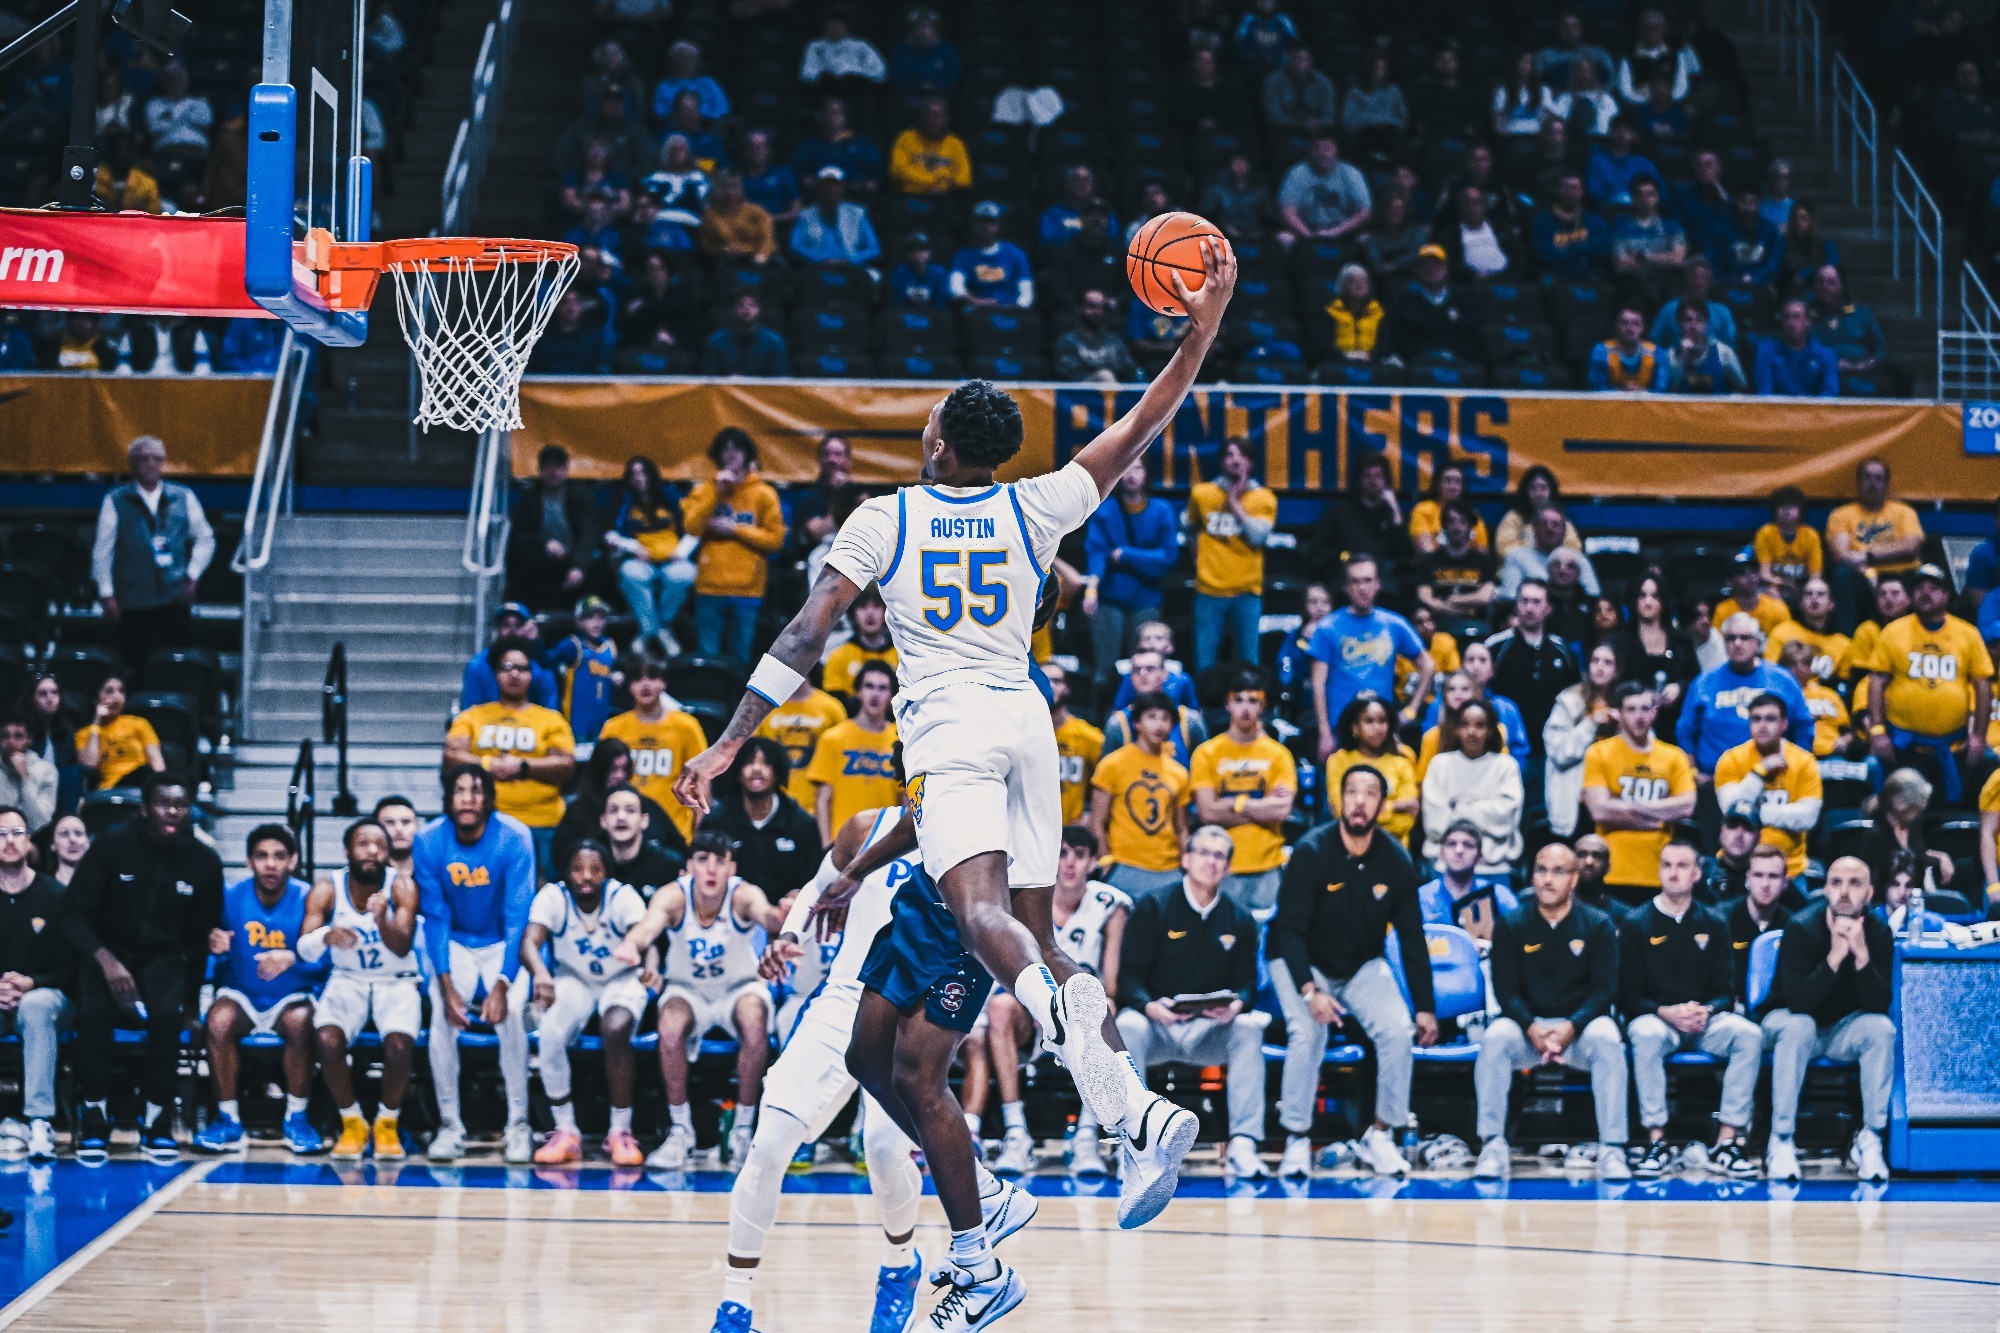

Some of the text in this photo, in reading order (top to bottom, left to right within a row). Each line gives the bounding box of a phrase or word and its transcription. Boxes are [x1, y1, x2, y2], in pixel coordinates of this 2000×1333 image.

[931, 517, 995, 538] AUSTIN
[920, 549, 1010, 634] 55
[1908, 652, 1956, 681] ZOO
[477, 724, 536, 751] ZOO
[1146, 799, 1159, 824] 3
[358, 948, 382, 969] 12
[692, 963, 724, 977] 25
